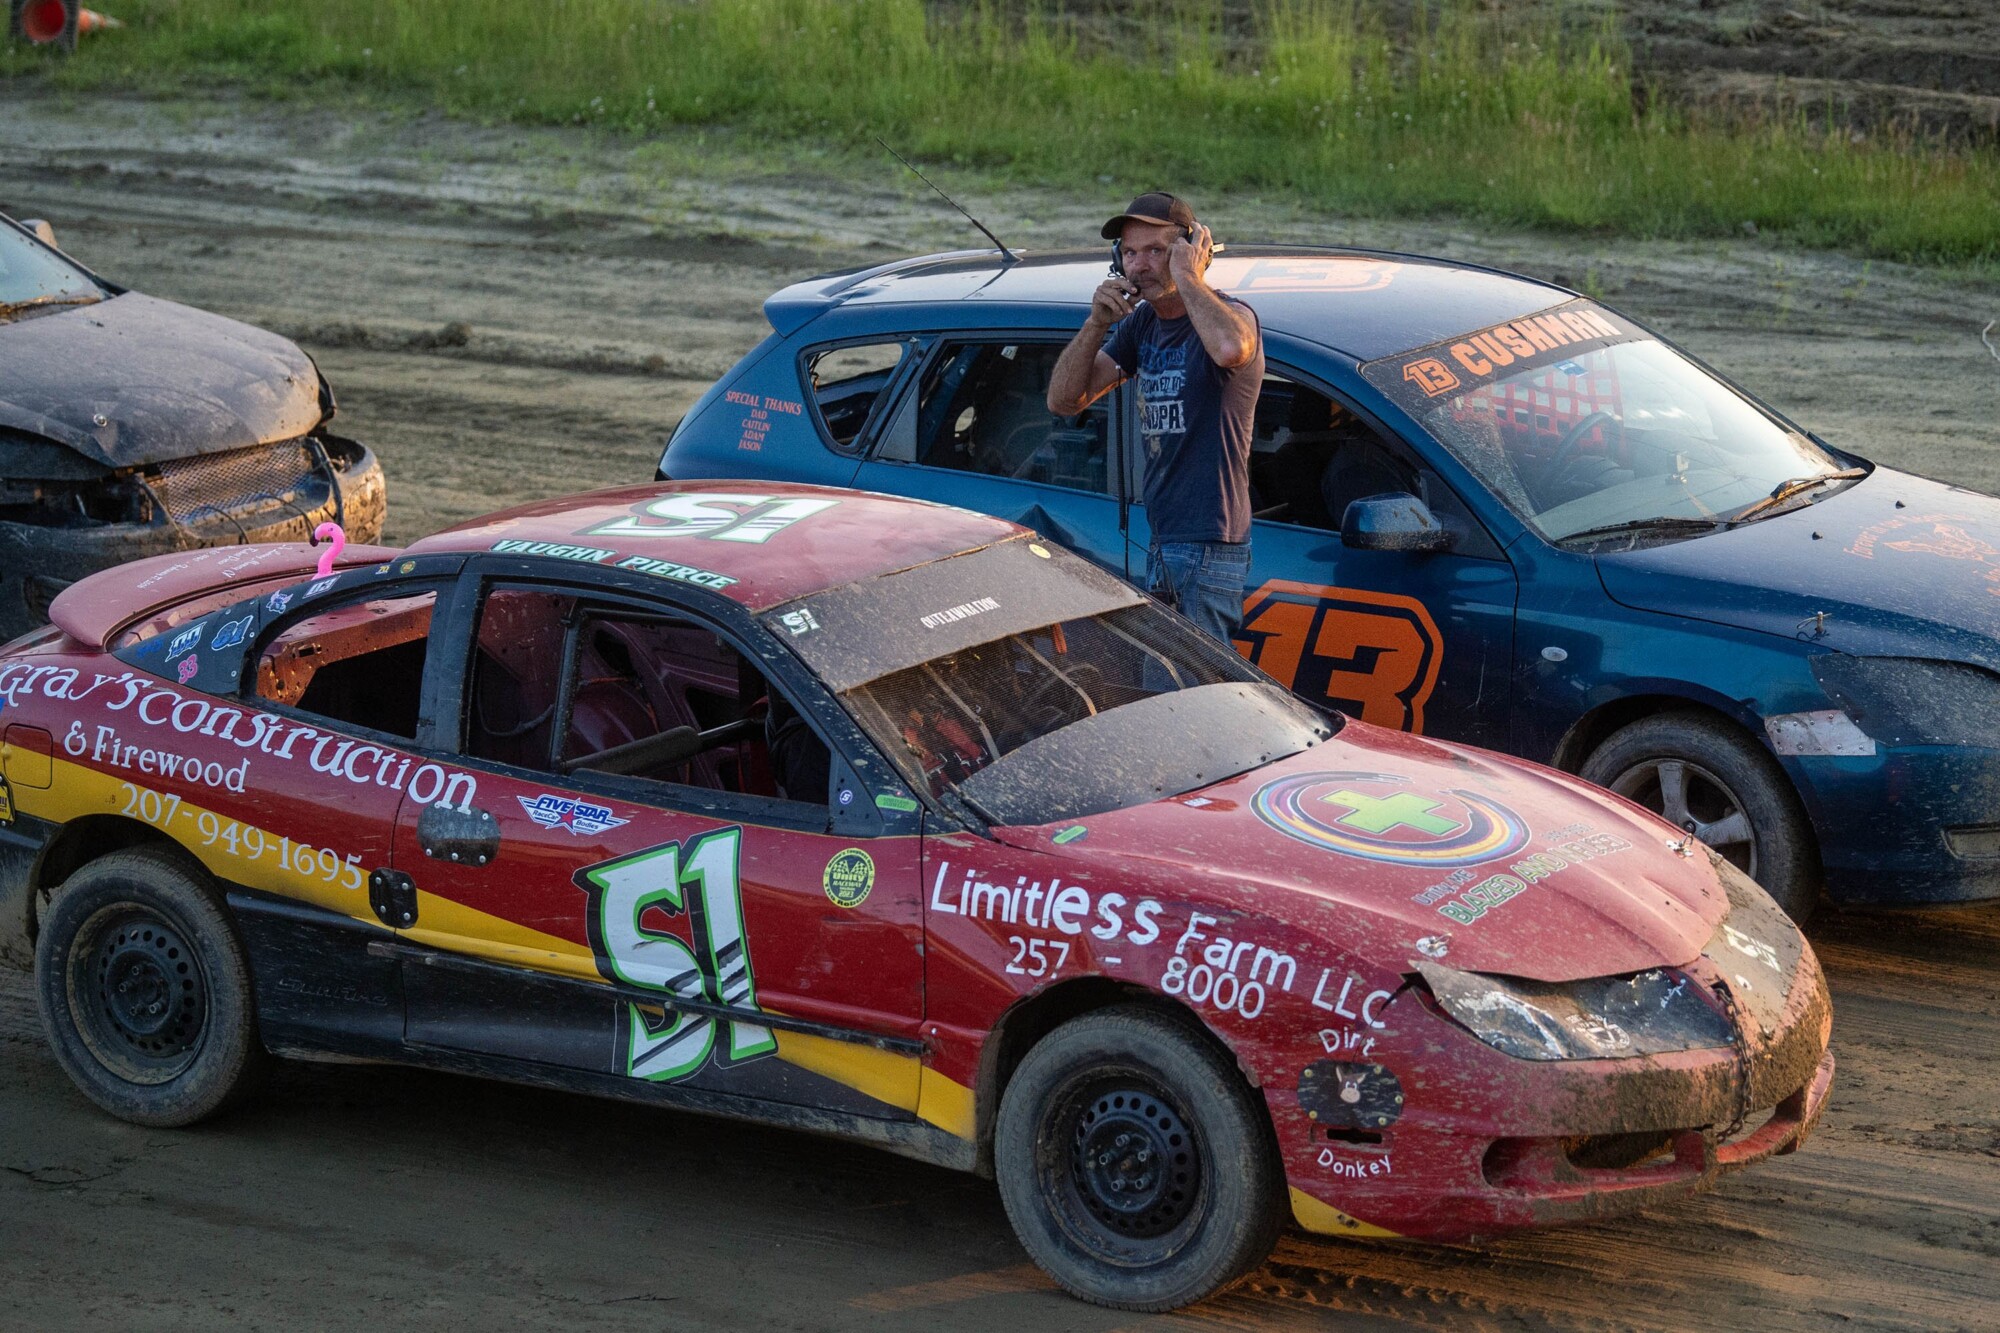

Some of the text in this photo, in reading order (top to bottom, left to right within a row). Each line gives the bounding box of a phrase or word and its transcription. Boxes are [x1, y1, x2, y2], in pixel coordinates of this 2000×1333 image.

[1403, 310, 1623, 398] 13 CUSHMAN
[725, 391, 802, 416] SPECIAL THANKS
[751, 409, 767, 420] DAD
[741, 418, 771, 432] CAITLIN
[743, 430, 765, 441] ADAM
[738, 440, 762, 452] JASON
[490, 539, 740, 590] VAUGHN PIERCE
[920, 596, 1001, 629] OUTLAWNATION
[178, 654, 198, 684] 33
[64, 721, 250, 793] & Firewood
[535, 796, 610, 824] FIVE STAR
[575, 819, 599, 830] Bodies
[122, 782, 362, 890] 207-949-1695
[1439, 873, 1527, 925] BLAZED
[1510, 853, 1568, 884] AND
[930, 861, 1396, 1029] Limitless Farm LLC
[1006, 936, 1069, 979] 257
[1161, 957, 1265, 1020] 8000
[1319, 1027, 1376, 1058] Dirt
[1317, 1148, 1392, 1180] Donkey
